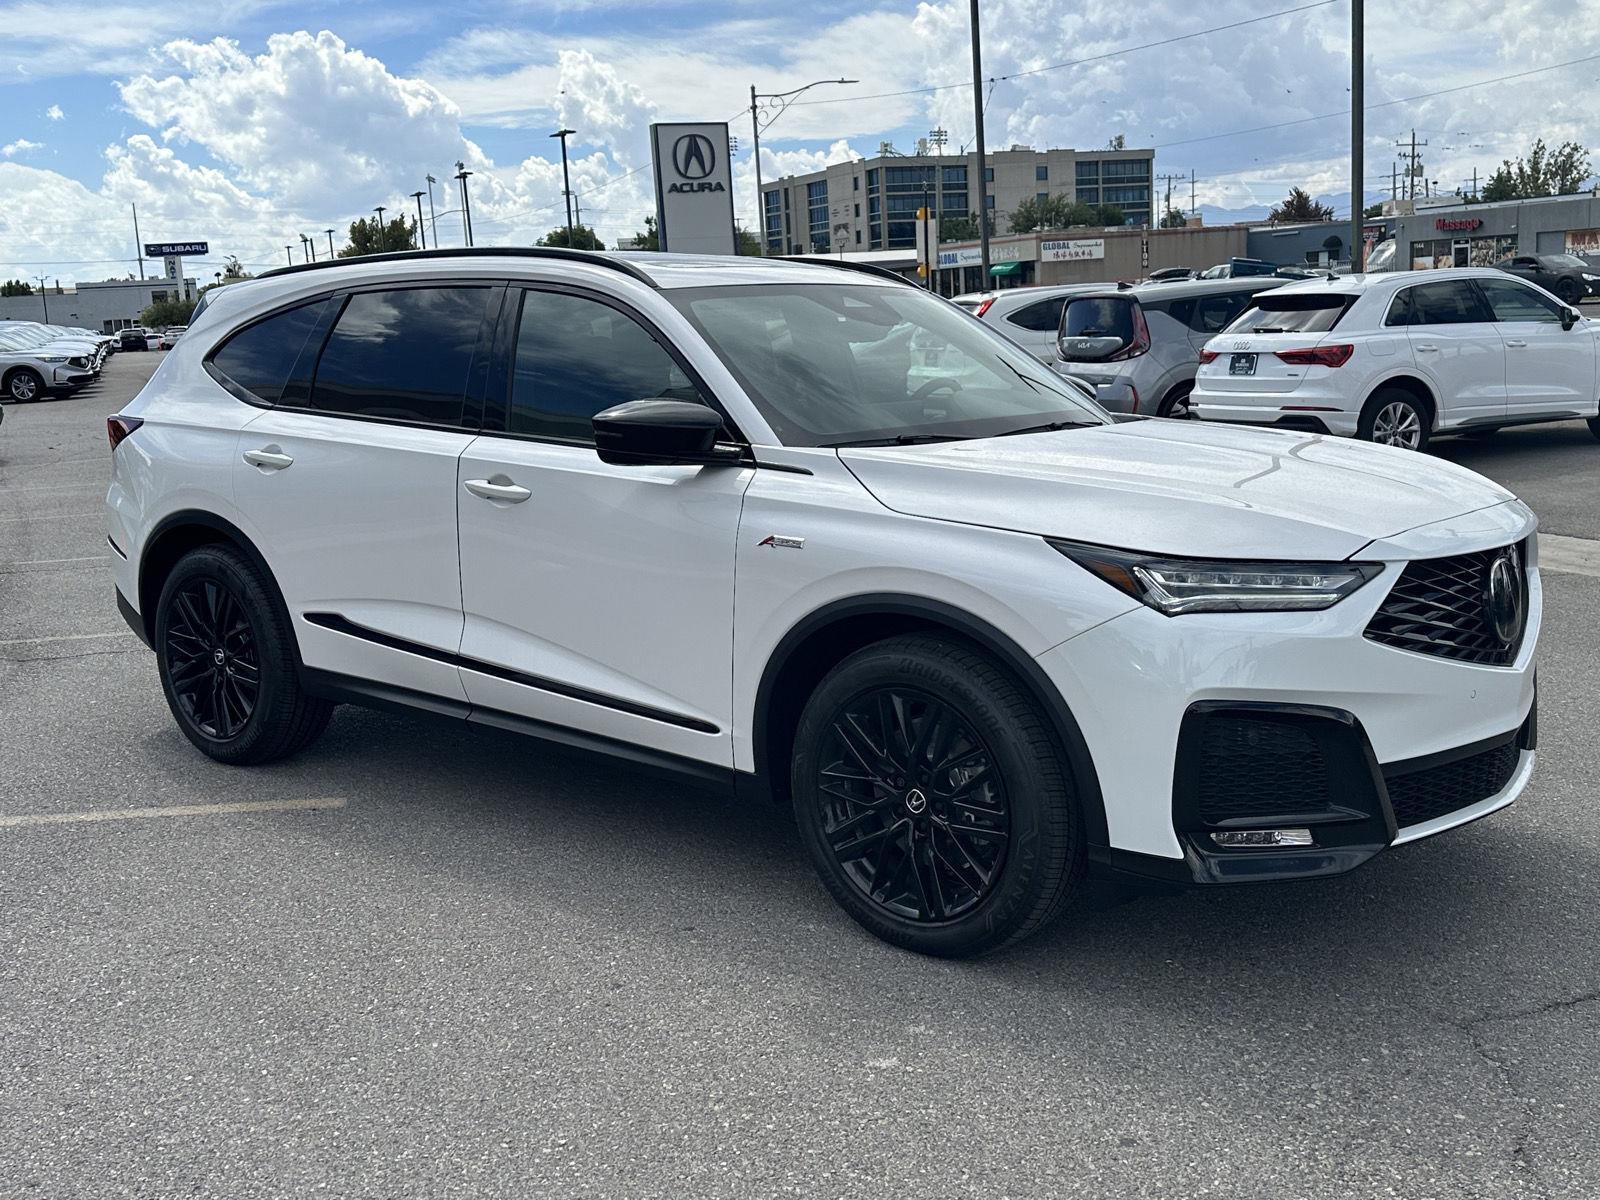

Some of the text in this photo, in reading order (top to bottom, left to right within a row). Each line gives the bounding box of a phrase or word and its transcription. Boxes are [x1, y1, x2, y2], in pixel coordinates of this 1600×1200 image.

[668, 181, 726, 193] ACURA
[1435, 217, 1480, 231] Massage
[162, 244, 207, 253] SUBARU
[1042, 241, 1071, 251] GLOBAL
